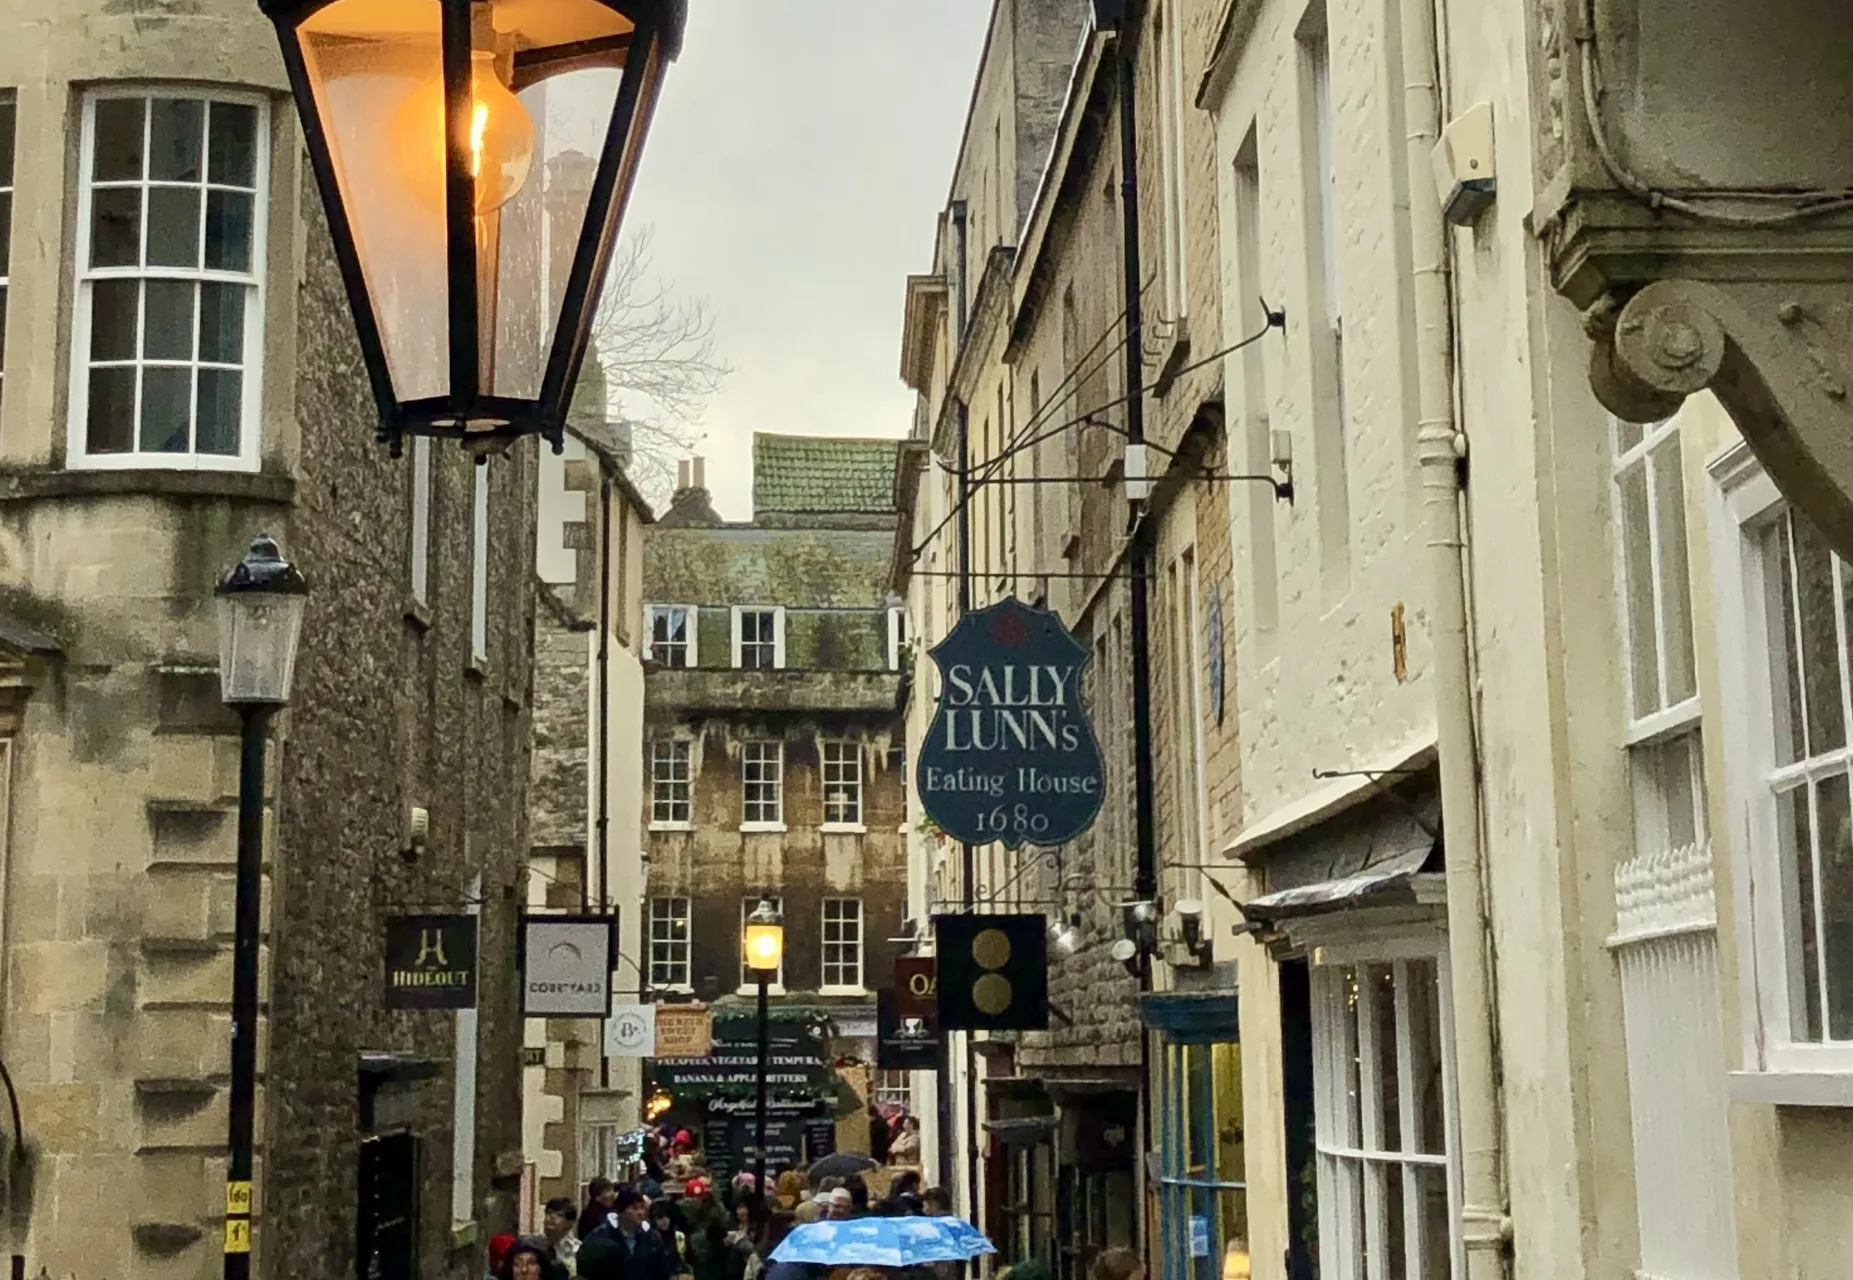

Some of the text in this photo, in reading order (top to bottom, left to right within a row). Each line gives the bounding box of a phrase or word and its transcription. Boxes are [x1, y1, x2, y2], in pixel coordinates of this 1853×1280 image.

[948, 664, 1075, 706] SALLY
[926, 767, 1097, 796] Eating House
[976, 803, 1049, 832] 1680
[393, 971, 469, 988] HIDEOUT
[764, 1073, 808, 1083] RITTERS
